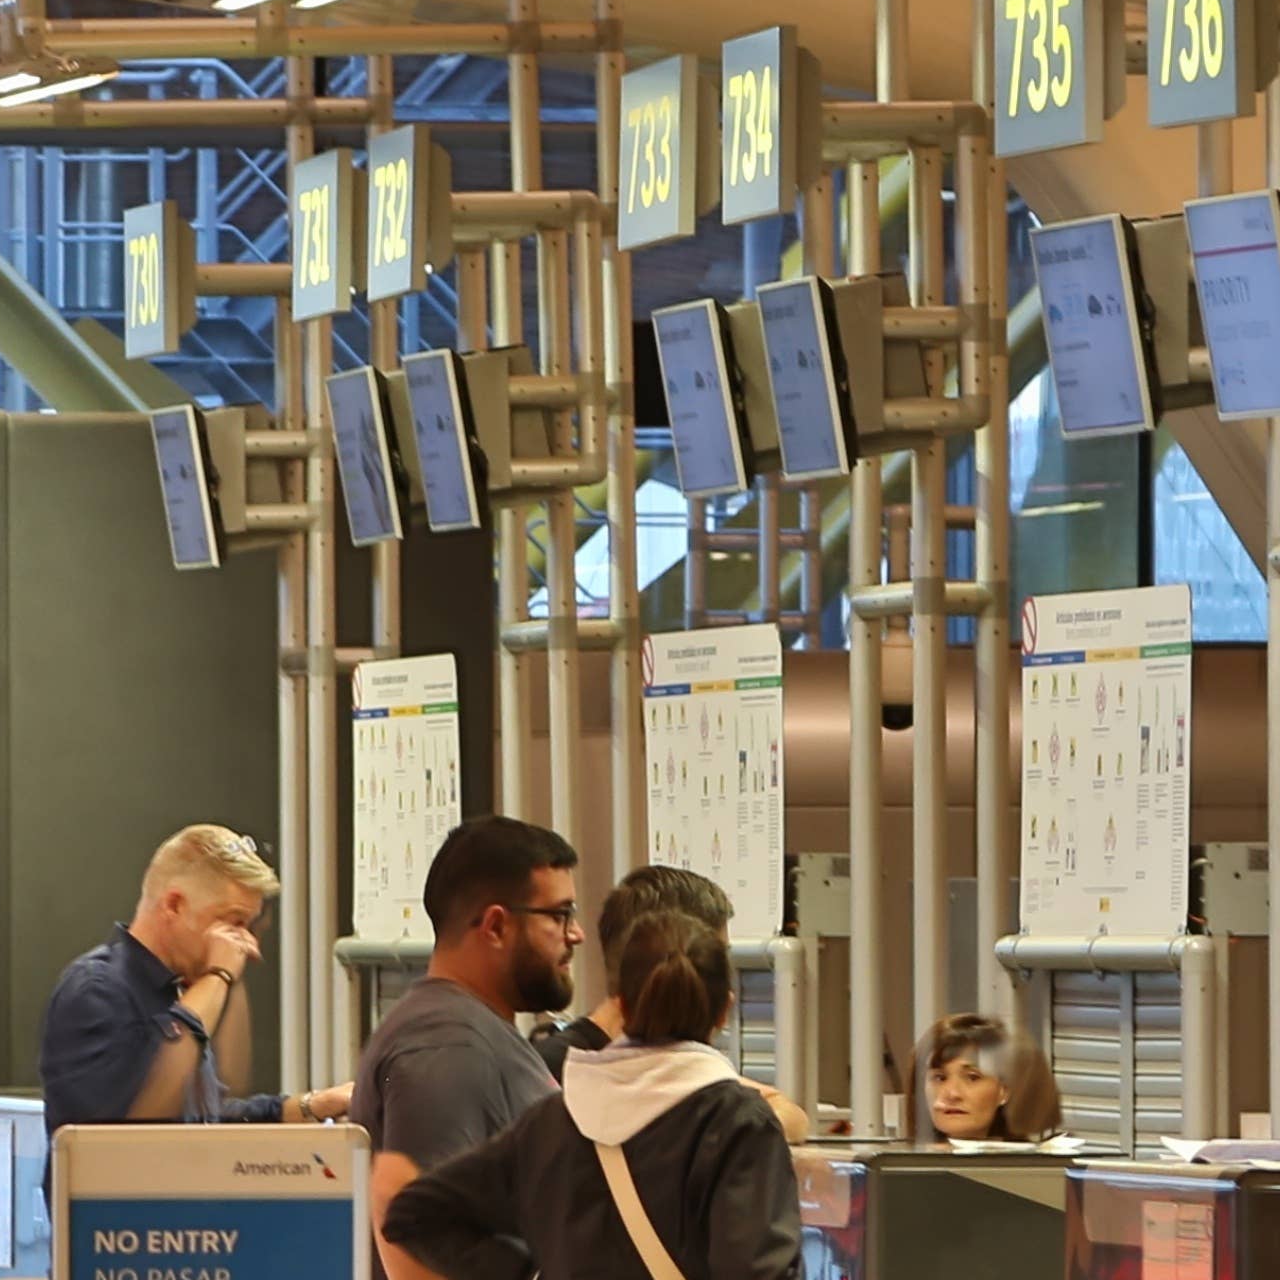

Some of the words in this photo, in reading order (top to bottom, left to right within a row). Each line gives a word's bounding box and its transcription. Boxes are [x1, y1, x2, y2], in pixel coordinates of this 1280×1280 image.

[627, 95, 673, 215] 733
[729, 65, 773, 186] 734
[299, 182, 329, 290] 731
[374, 157, 408, 268] 732
[129, 235, 160, 328] 730
[232, 1160, 313, 1176] American
[94, 1230, 140, 1255] NO
[147, 1230, 239, 1254] ENTRY
